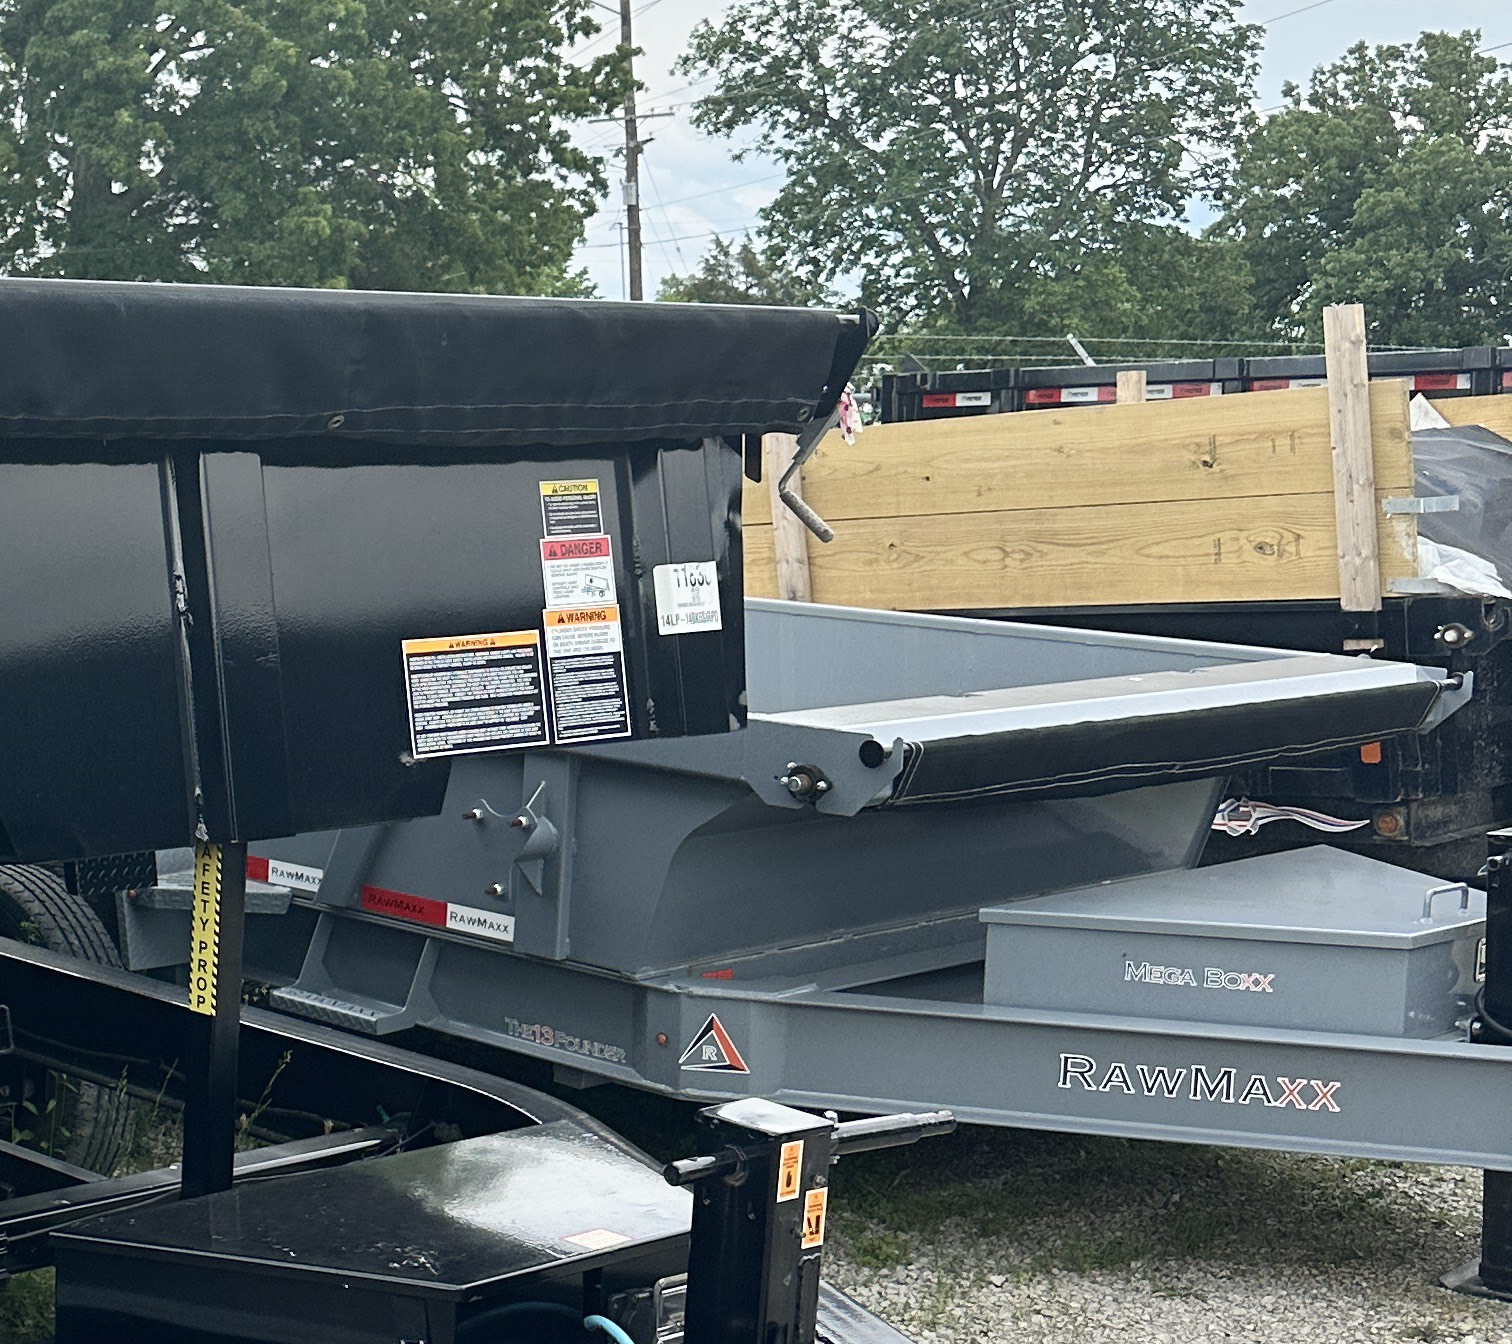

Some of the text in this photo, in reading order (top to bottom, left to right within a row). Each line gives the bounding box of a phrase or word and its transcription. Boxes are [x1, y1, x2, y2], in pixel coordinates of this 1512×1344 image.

[559, 484, 588, 493] CAUTION
[560, 542, 603, 556] DANGER
[567, 610, 607, 622] WARNING
[455, 639, 488, 648] WARNING
[197, 844, 212, 1008] AFETY PROP
